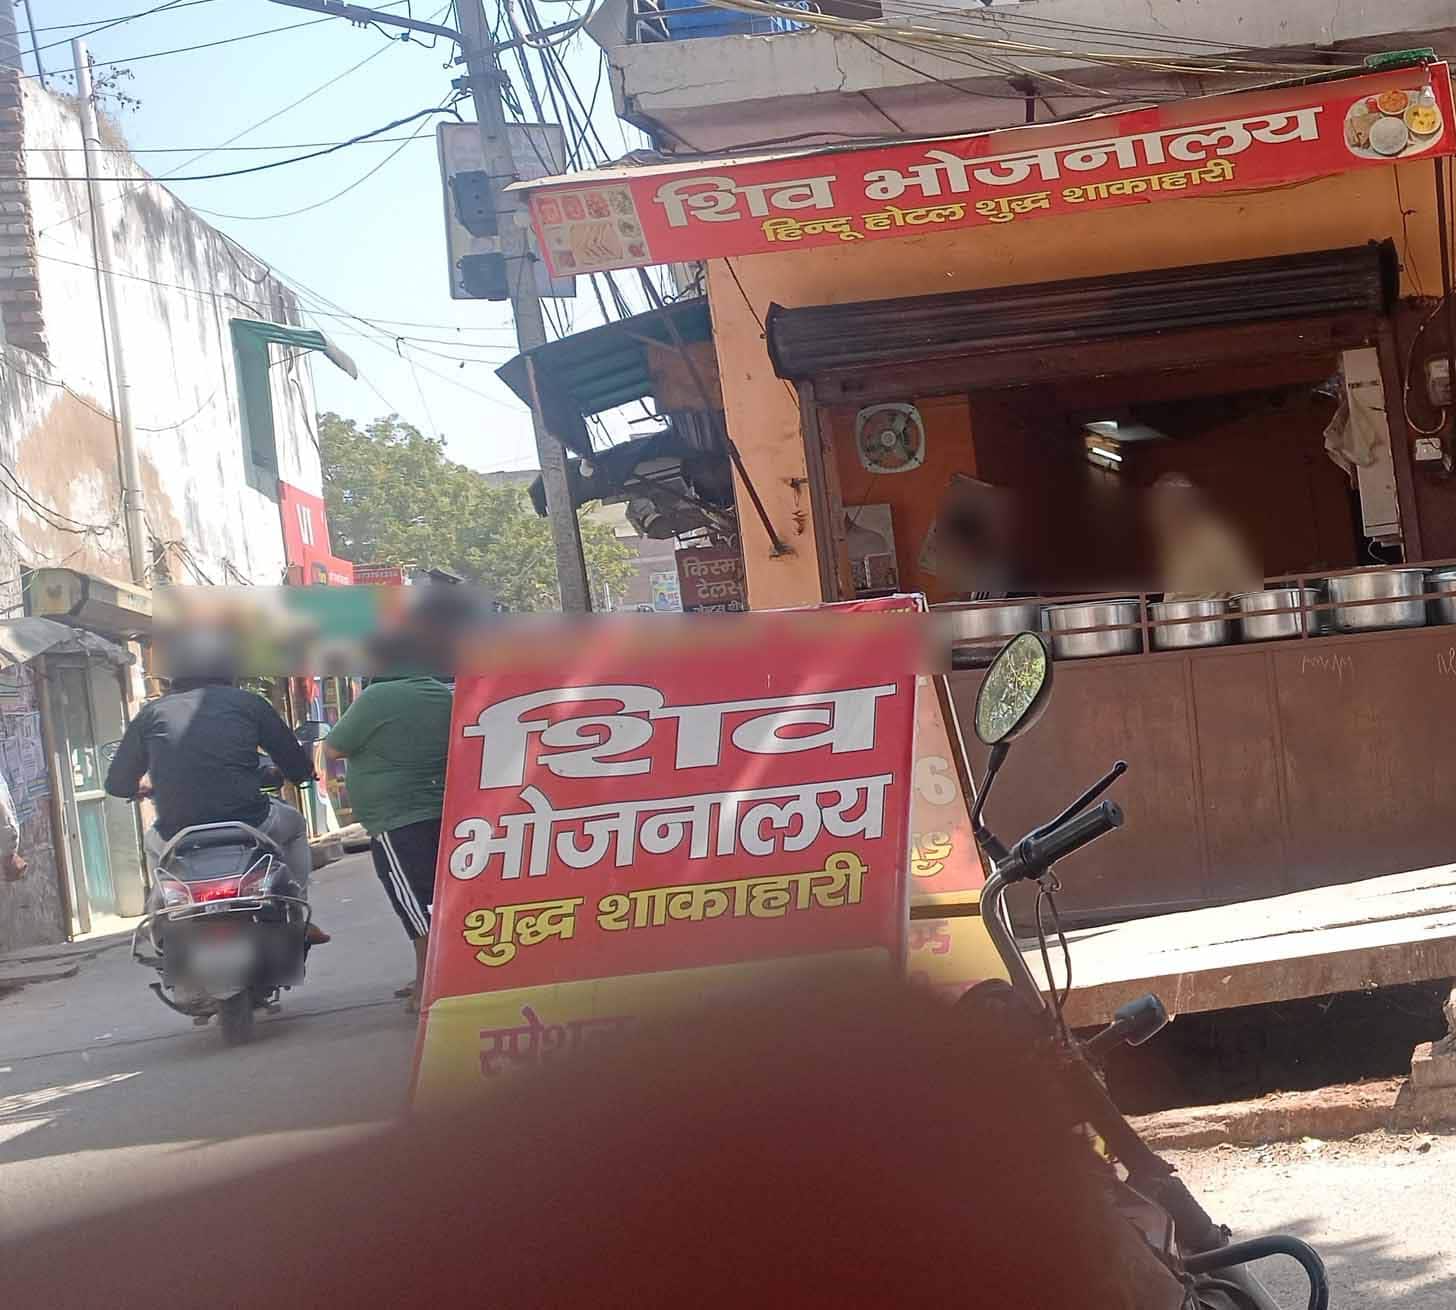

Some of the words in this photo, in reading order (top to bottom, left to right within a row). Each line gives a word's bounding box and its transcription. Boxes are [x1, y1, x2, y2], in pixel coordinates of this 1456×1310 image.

[655, 174, 836, 229] शिव
[864, 102, 1324, 201] भोजनालय
[760, 217, 863, 243] हिन्दू
[864, 203, 967, 233] होटल
[974, 190, 1051, 223] शुद्ध
[1062, 160, 1236, 205] शाकाहारी
[463, 683, 897, 790] शिव
[449, 772, 894, 881] भोजनालय
[462, 896, 585, 968] शुद्ध
[597, 851, 870, 931] शाकाहारी
